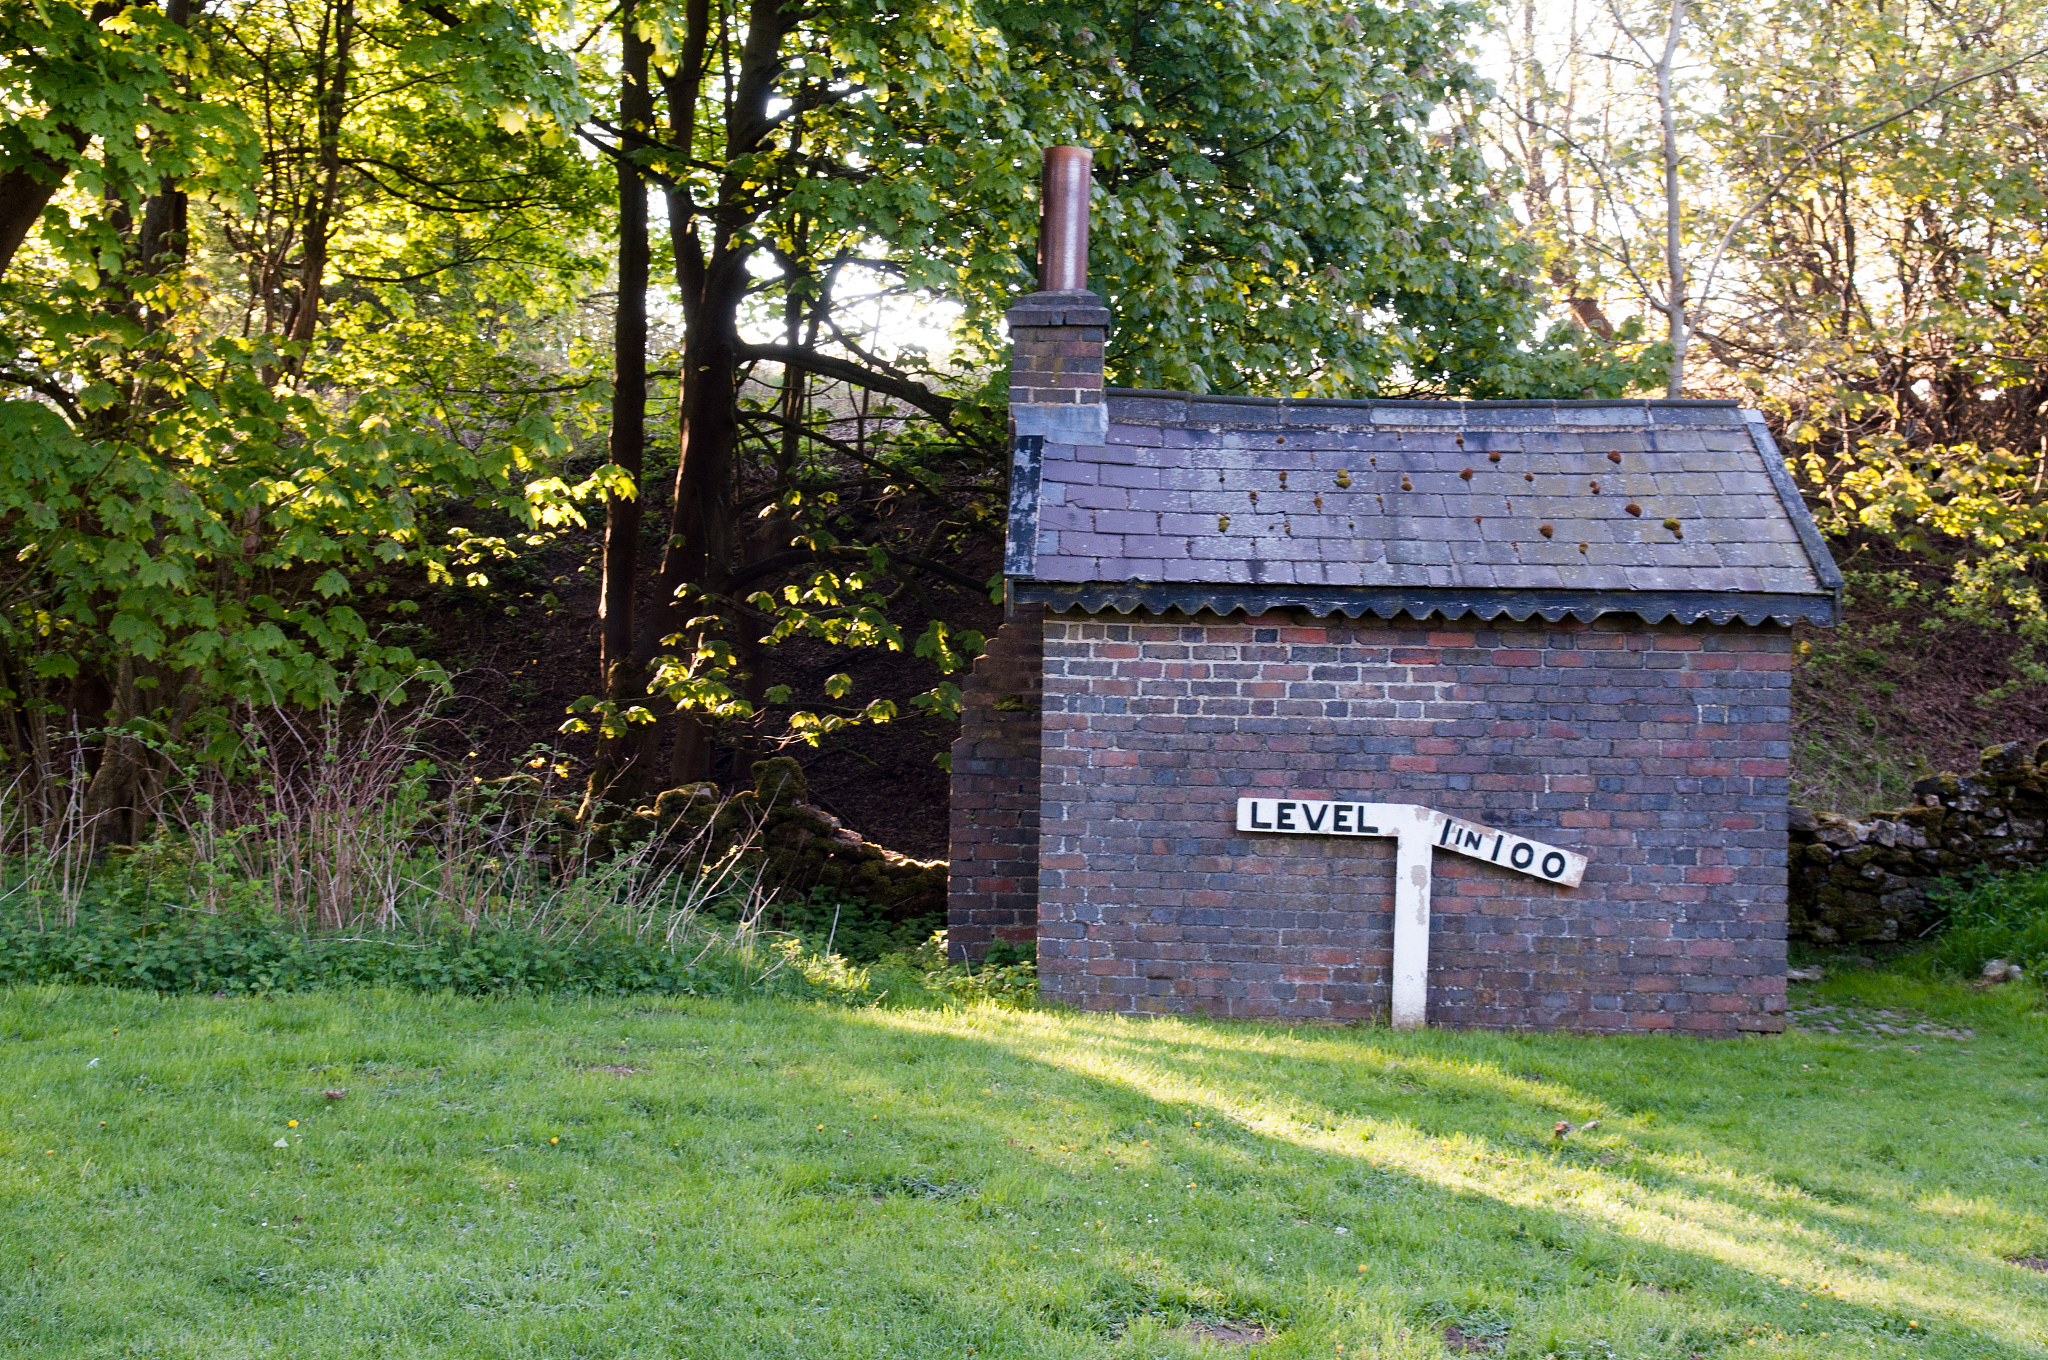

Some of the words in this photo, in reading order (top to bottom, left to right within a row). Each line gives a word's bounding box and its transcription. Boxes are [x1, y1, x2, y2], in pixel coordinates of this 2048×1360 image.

[1251, 801, 1379, 834] LEVEL
[1455, 828, 1482, 851] IN
[1491, 834, 1566, 879] 100
